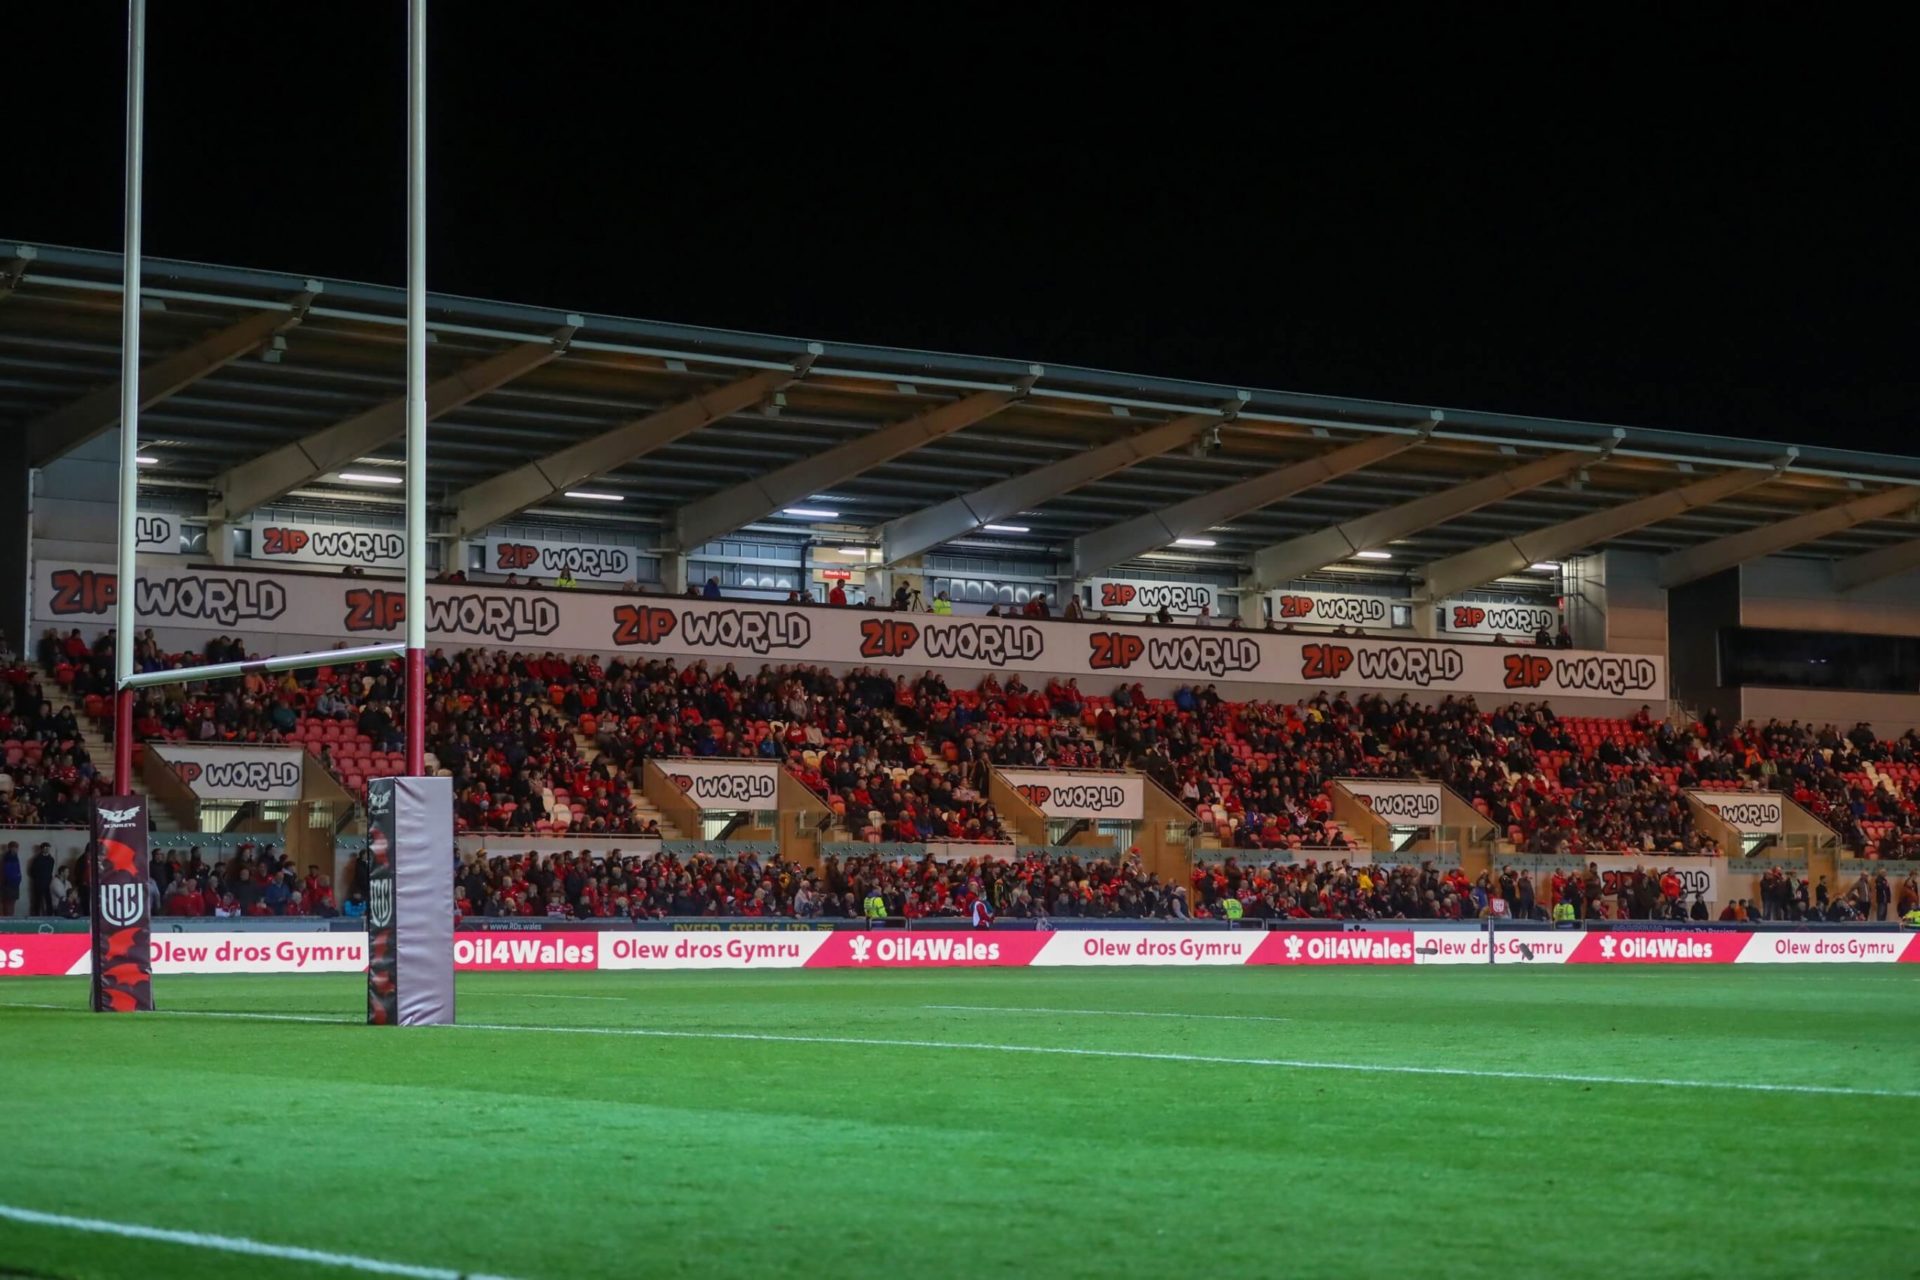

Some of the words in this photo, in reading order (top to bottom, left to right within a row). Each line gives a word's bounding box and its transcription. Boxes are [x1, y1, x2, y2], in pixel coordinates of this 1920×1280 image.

[263, 527, 309, 554] ZIP
[312, 532, 404, 562] WORLD
[497, 544, 539, 569] ZIP
[543, 547, 628, 576] WORLD
[50, 570, 117, 615] ZIP
[134, 577, 286, 625] WORLD
[1101, 583, 1135, 606] ZIP
[1139, 586, 1210, 612] WORLD
[1280, 596, 1313, 618] ZIP
[1317, 598, 1385, 623] WORLD
[345, 588, 406, 631] ZIP
[425, 595, 560, 641] WORLD
[1453, 606, 1485, 628] ZIP
[1488, 608, 1553, 633] WORLD
[613, 605, 677, 645] ZIP
[682, 609, 811, 653] WORLD
[861, 619, 919, 658] ZIP
[924, 623, 1043, 665] WORLD
[1089, 632, 1144, 670] ZIP
[1149, 636, 1260, 676] WORLD
[1301, 644, 1353, 680] ZIP
[1358, 647, 1463, 686] WORLD
[1504, 654, 1552, 688] ZIP
[1557, 657, 1656, 696] WORLD
[206, 761, 299, 791] WORLD
[696, 774, 775, 802] WORLD
[1054, 785, 1124, 811] WORLD
[1375, 794, 1439, 818] WORLD
[1722, 804, 1779, 826] WORLD
[150, 941, 208, 962] Olew
[215, 940, 271, 962] dros
[276, 941, 361, 967] Gymru
[454, 939, 594, 964] Oil4Wales
[613, 939, 668, 958] Olew
[675, 939, 722, 958] dros
[727, 939, 799, 963] Gymru
[877, 937, 999, 961] Oil4Wales
[1084, 938, 1130, 956] Olew
[1136, 938, 1176, 956] dros
[1180, 938, 1242, 960] Gymru
[1307, 937, 1412, 959] Oil4Wales
[1425, 938, 1466, 955] Olew
[1620, 937, 1713, 958] Oil4Wales
[1775, 939, 1810, 954] Olew
[1815, 938, 1845, 954] dros
[1848, 939, 1894, 958] Gymru
